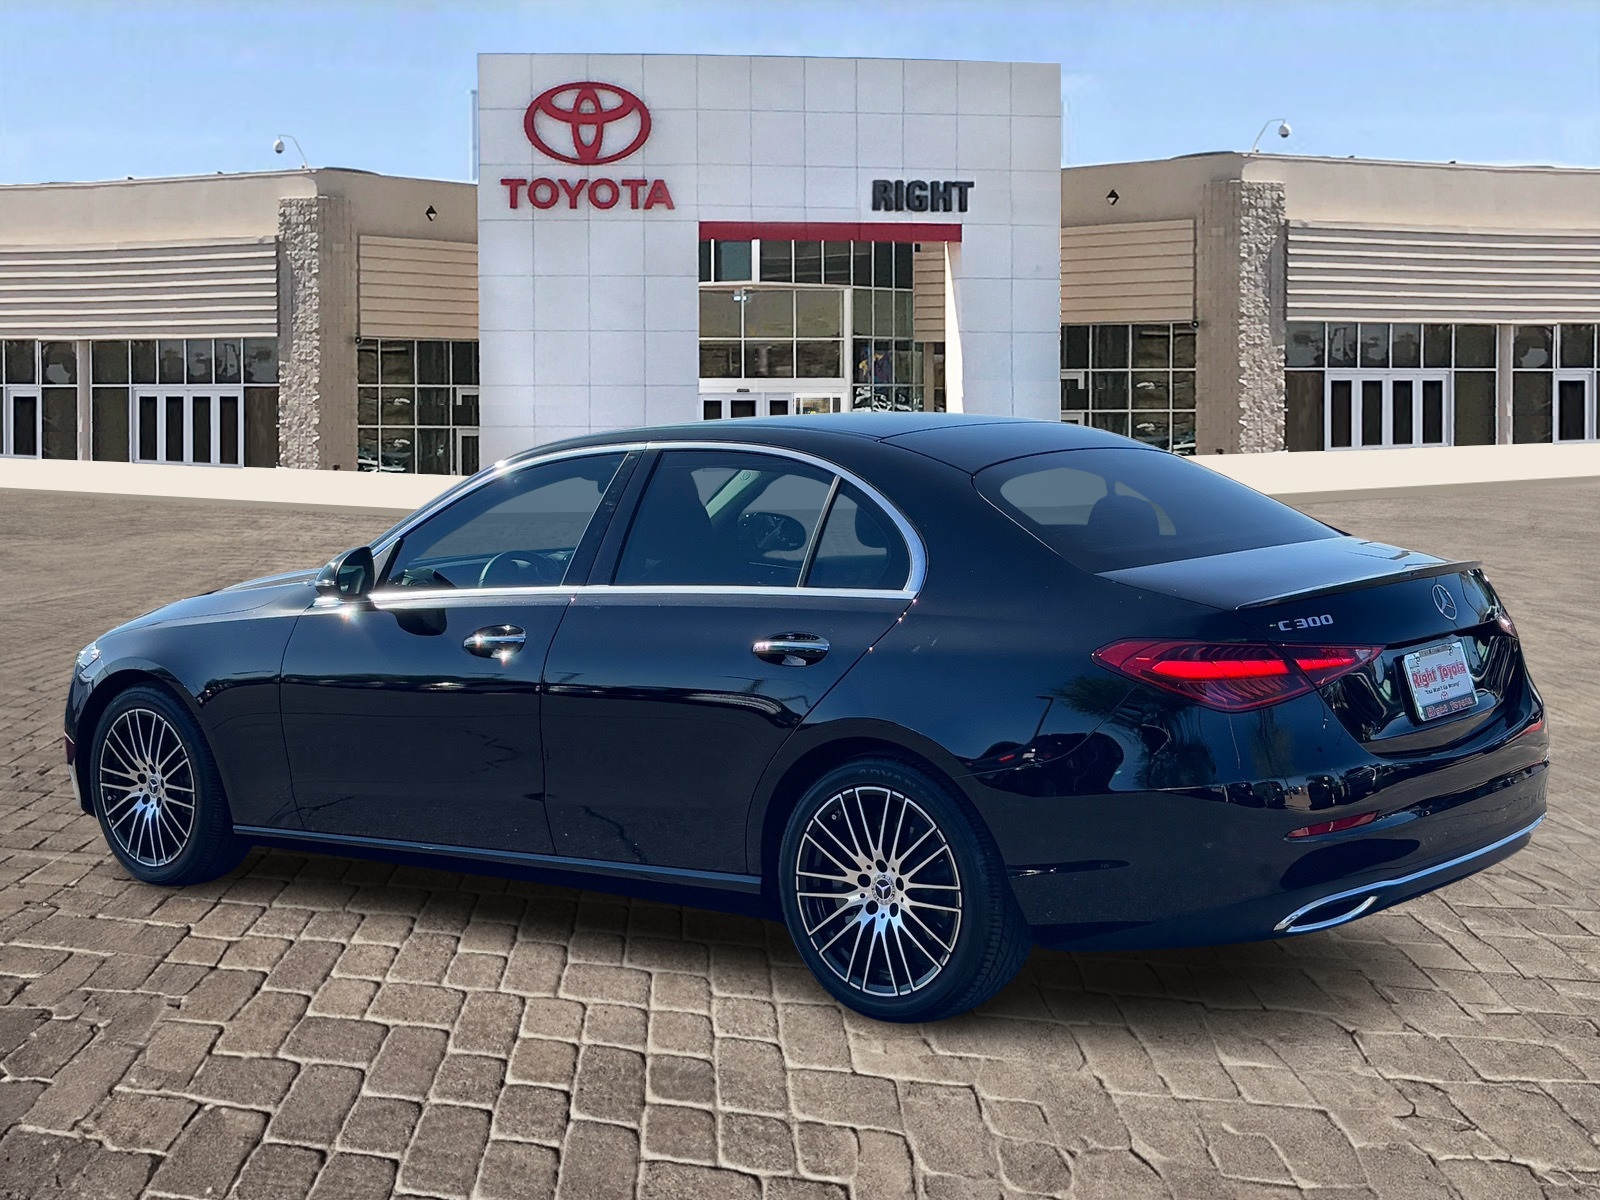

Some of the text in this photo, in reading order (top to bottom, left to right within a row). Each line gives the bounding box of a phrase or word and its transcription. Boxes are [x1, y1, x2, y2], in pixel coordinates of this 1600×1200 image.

[500, 178, 675, 210] TOYOTA
[872, 180, 975, 212] RIGHT
[1278, 614, 1334, 631] C 300
[1412, 661, 1466, 688] Right Toyota
